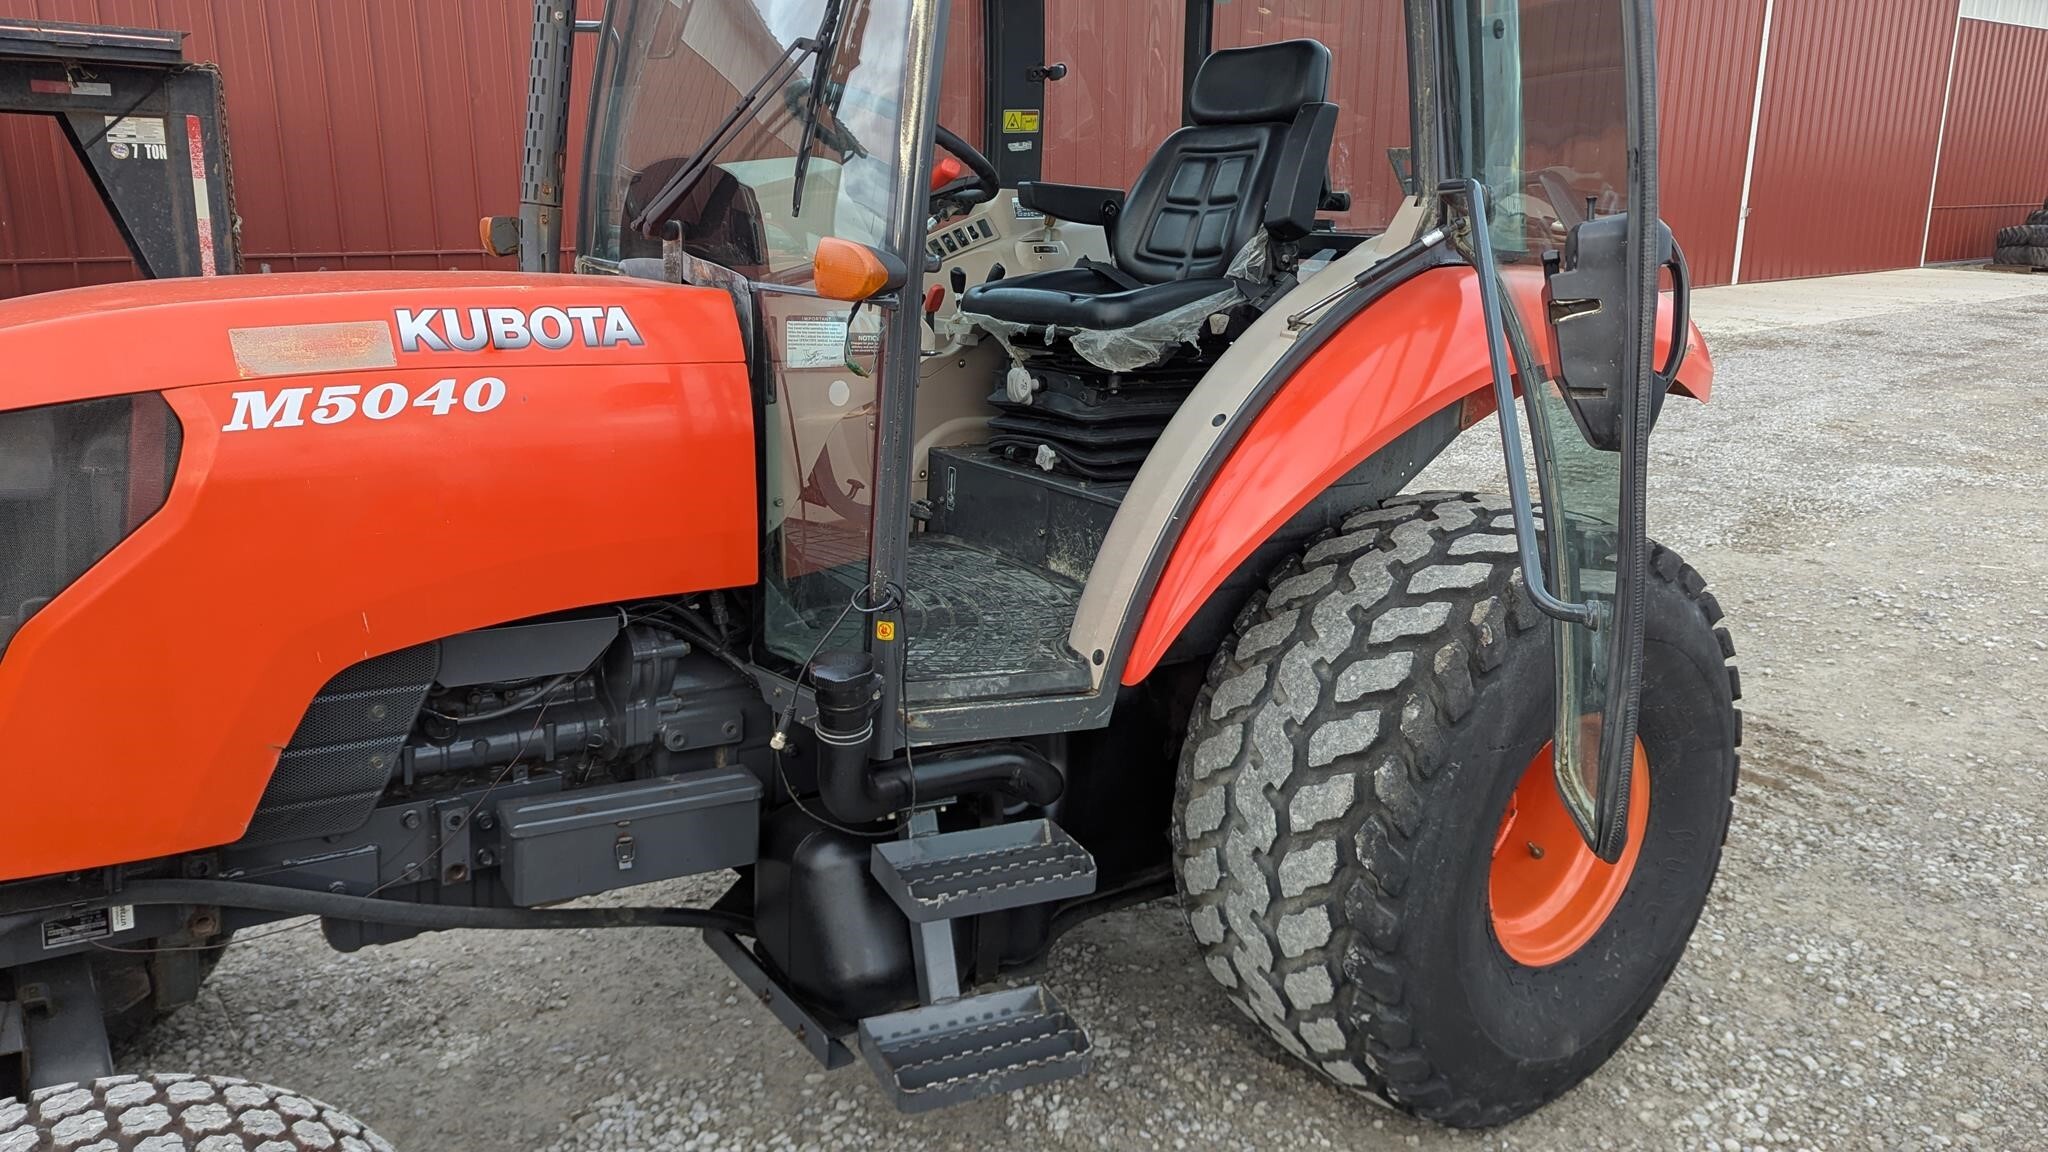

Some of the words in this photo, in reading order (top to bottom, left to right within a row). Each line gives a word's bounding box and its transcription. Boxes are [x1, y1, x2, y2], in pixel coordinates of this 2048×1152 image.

[131, 143, 139, 159] 7
[144, 144, 168, 160] TON
[394, 306, 645, 353] KUBOTA
[221, 376, 507, 433] M5040
